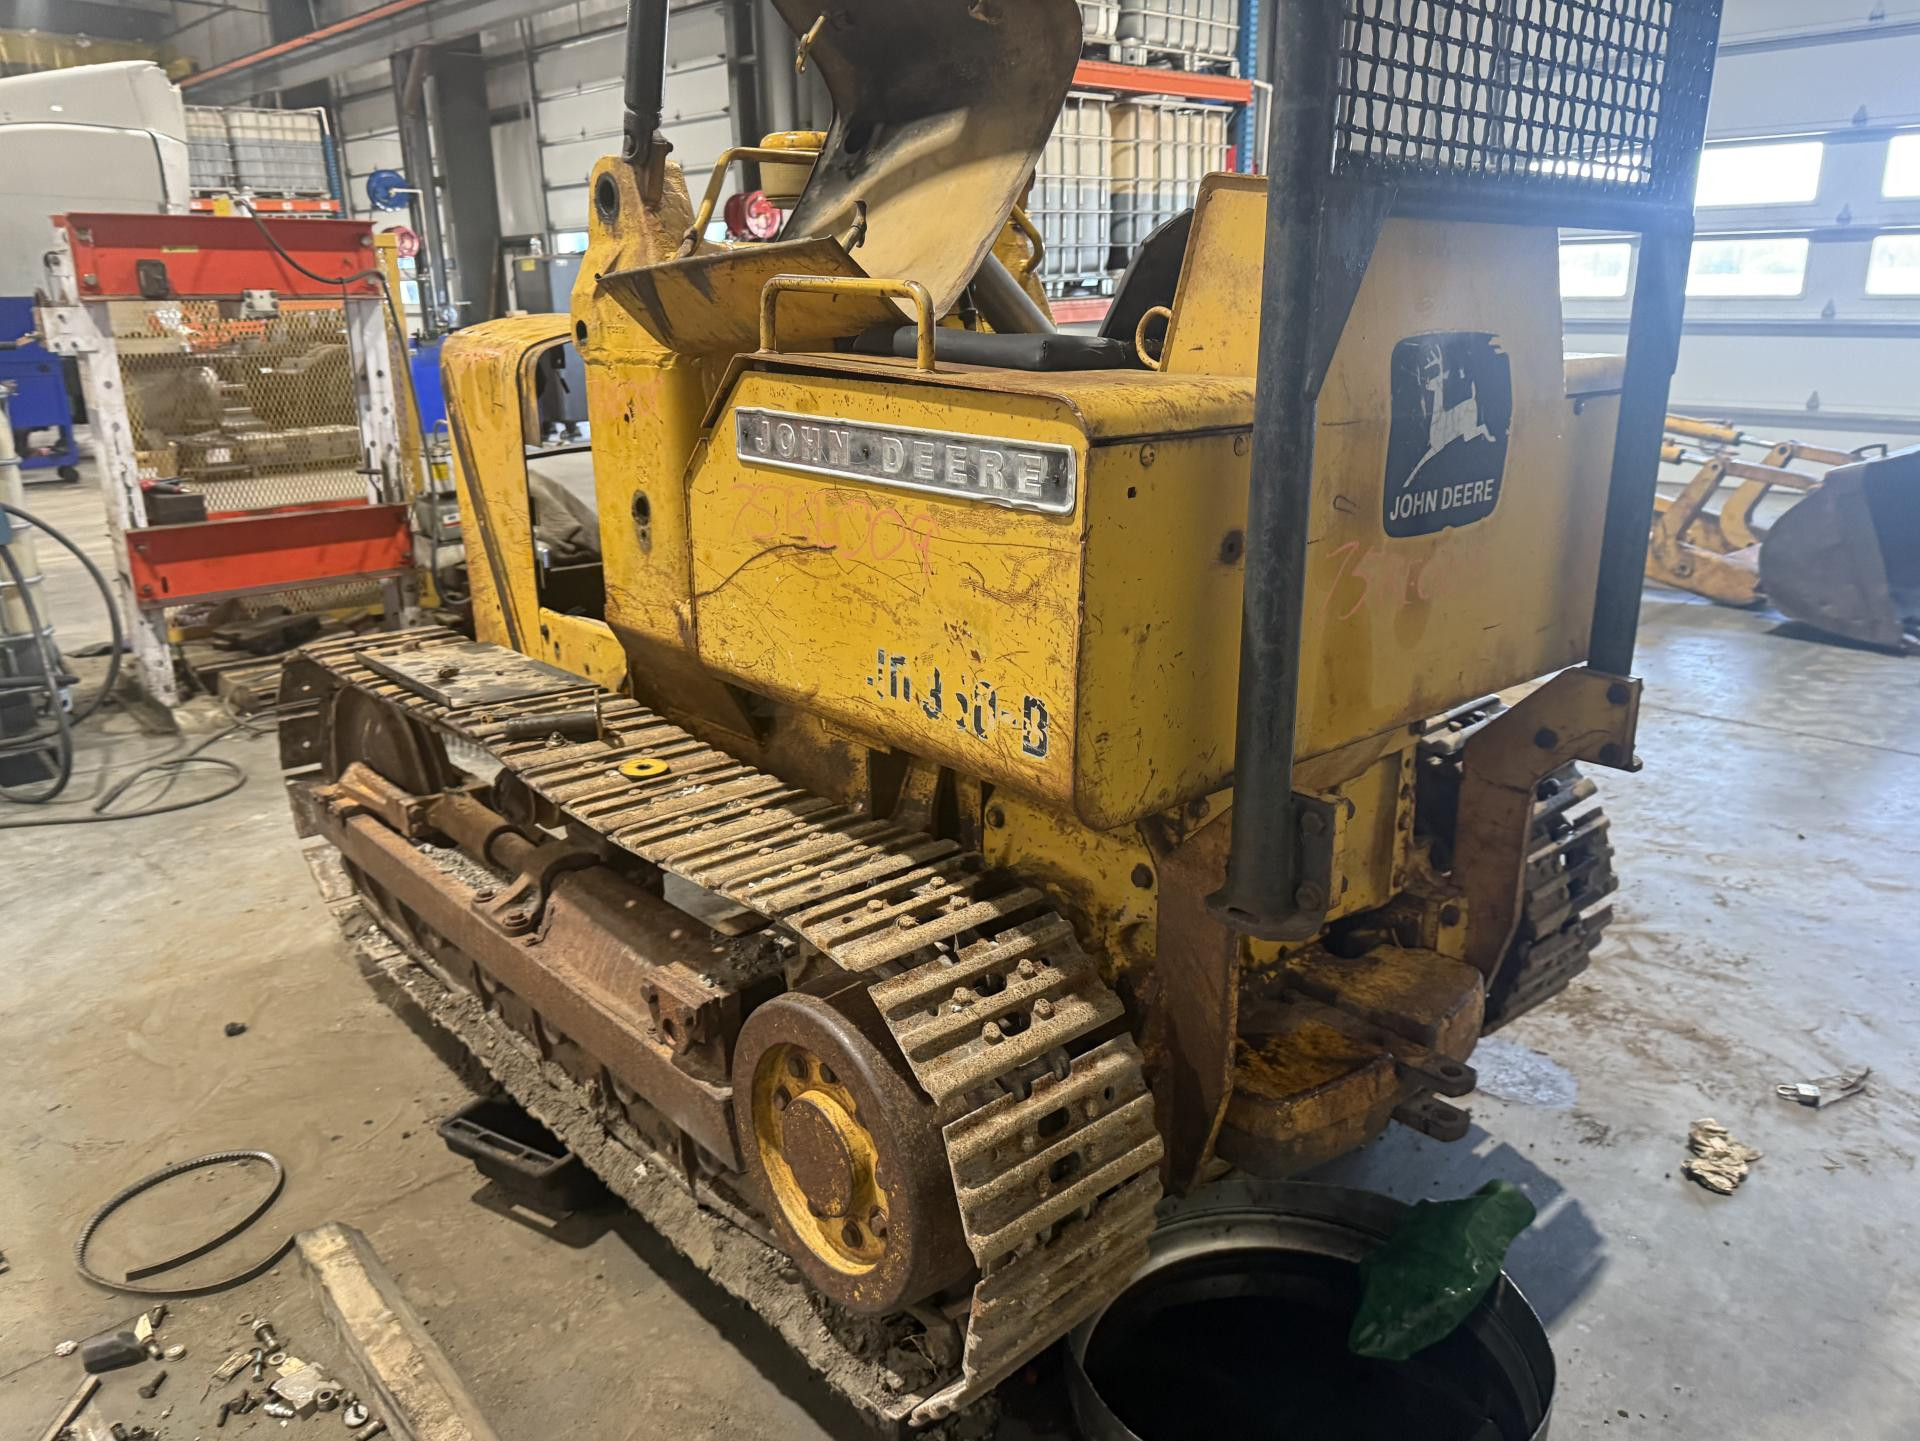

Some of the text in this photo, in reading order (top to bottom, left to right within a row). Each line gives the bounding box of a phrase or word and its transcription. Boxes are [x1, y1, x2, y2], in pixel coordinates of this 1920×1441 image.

[754, 421, 1043, 497] JOHN DEERE
[1389, 479, 1495, 521] JOHN DEERE
